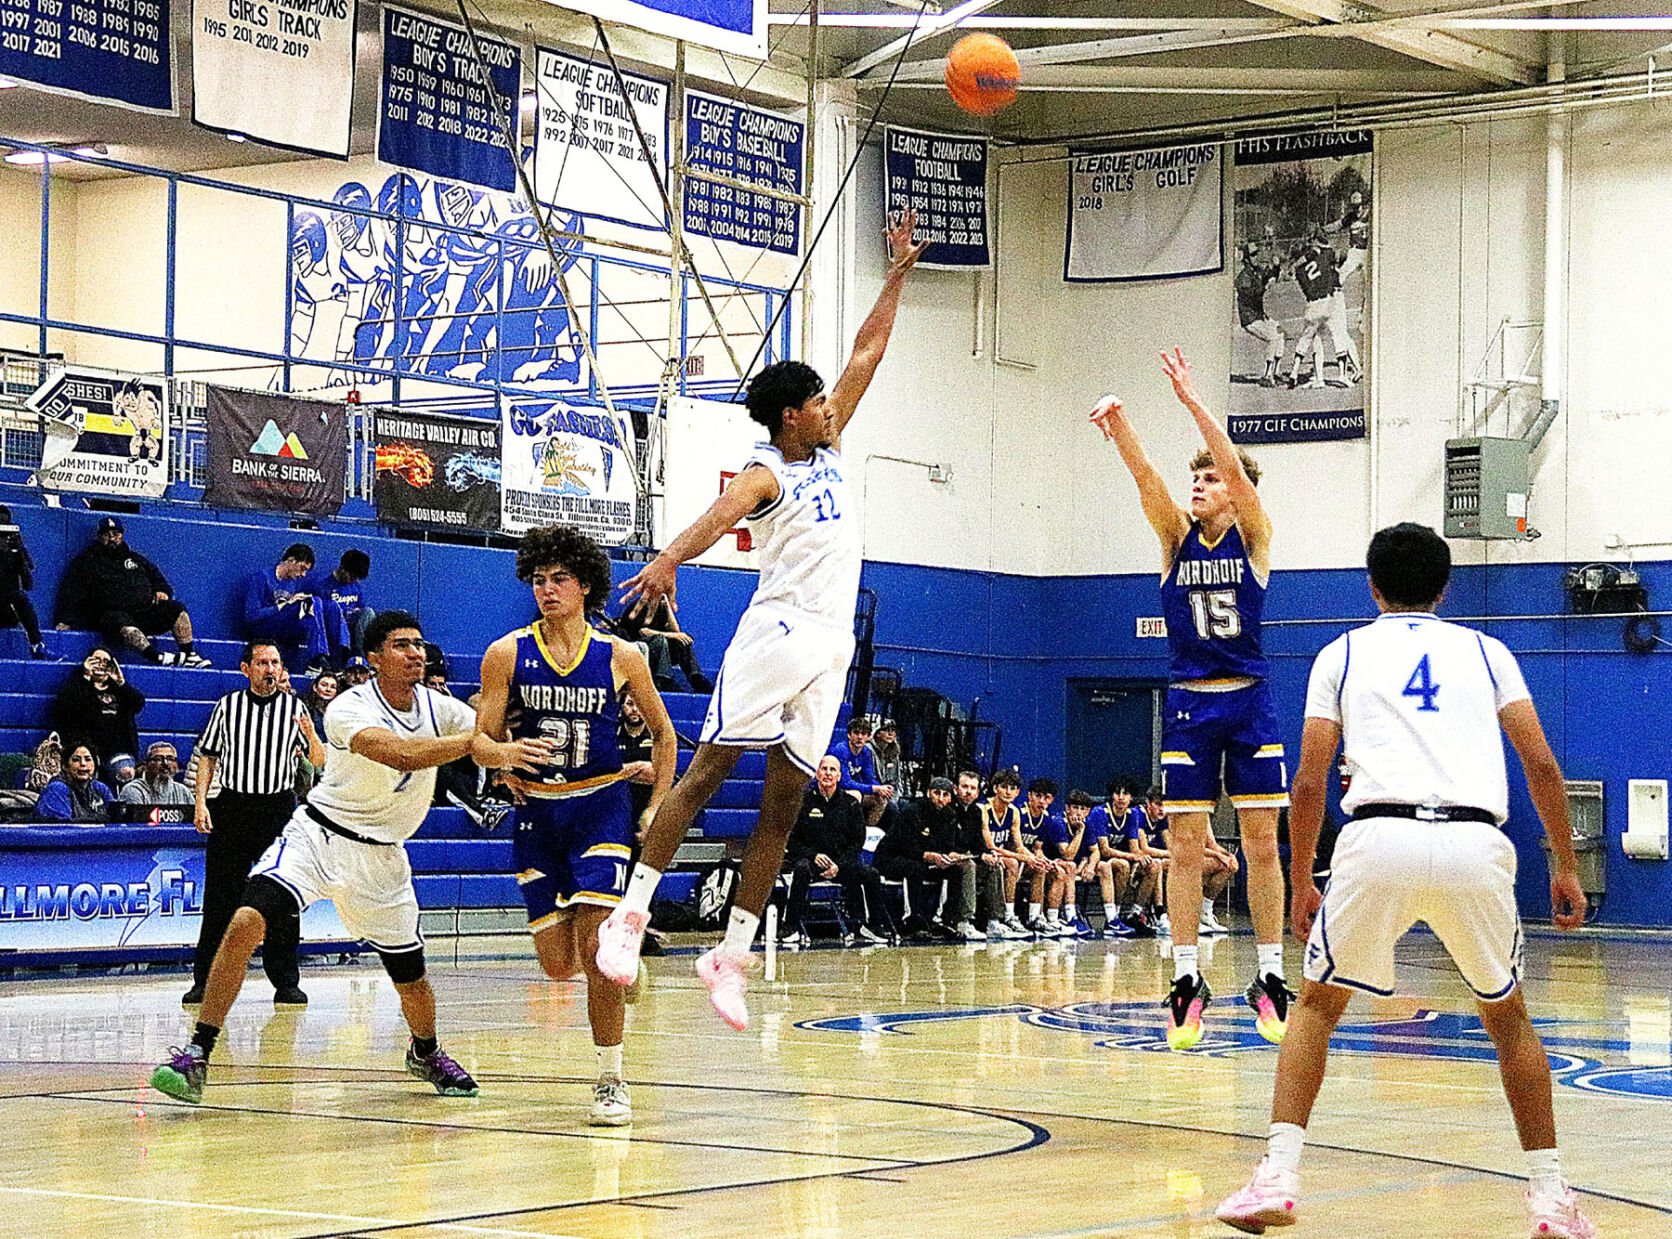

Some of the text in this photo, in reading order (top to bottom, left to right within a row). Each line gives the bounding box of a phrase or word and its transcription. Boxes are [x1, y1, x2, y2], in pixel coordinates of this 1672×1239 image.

[38, 0, 63, 17] 1987
[71, 4, 97, 25] 1988
[102, 12, 129, 34] 1989
[134, 0, 160, 21] 1985
[1, 9, 30, 30] 1997
[34, 18, 61, 39] 2001
[100, 35, 129, 56] 2015
[133, 43, 159, 65] 2016
[278, 10, 321, 41] TRACK
[391, 14, 442, 48] LEAGUE
[2, 31, 61, 59] 2017 2021
[282, 40, 309, 58] 2019
[543, 57, 593, 88] LEAGUE
[442, 79, 464, 97] 1960
[575, 90, 631, 122] SOFTBALL
[388, 102, 408, 121] 2011
[438, 116, 461, 135] 2018
[464, 124, 488, 143] 2022
[691, 99, 799, 143] LEAGUE CHAMPIONS
[737, 131, 787, 163] BASEBALL
[892, 134, 928, 157] LEAGUE
[1075, 144, 1215, 173] LEAGUE CHAMPIONS
[915, 159, 961, 181] FOOTBALL
[1156, 167, 1196, 188] GOLF
[1080, 196, 1102, 210] 2018
[377, 418, 498, 448] HERITAGE VALLEY AIR CO.
[1232, 416, 1363, 433] 1977 CIF CHAMPIONS
[49, 471, 148, 489] OUR COMMUNITY
[59, 458, 148, 476] OMMITMENT TO
[232, 458, 267, 477] BANK
[562, 496, 573, 512] THE
[1141, 620, 1163, 634] EXIT
[1189, 590, 1242, 640] 15
[1402, 653, 1440, 711] 4
[537, 716, 591, 769] 21
[159, 809, 180, 823] POSS
